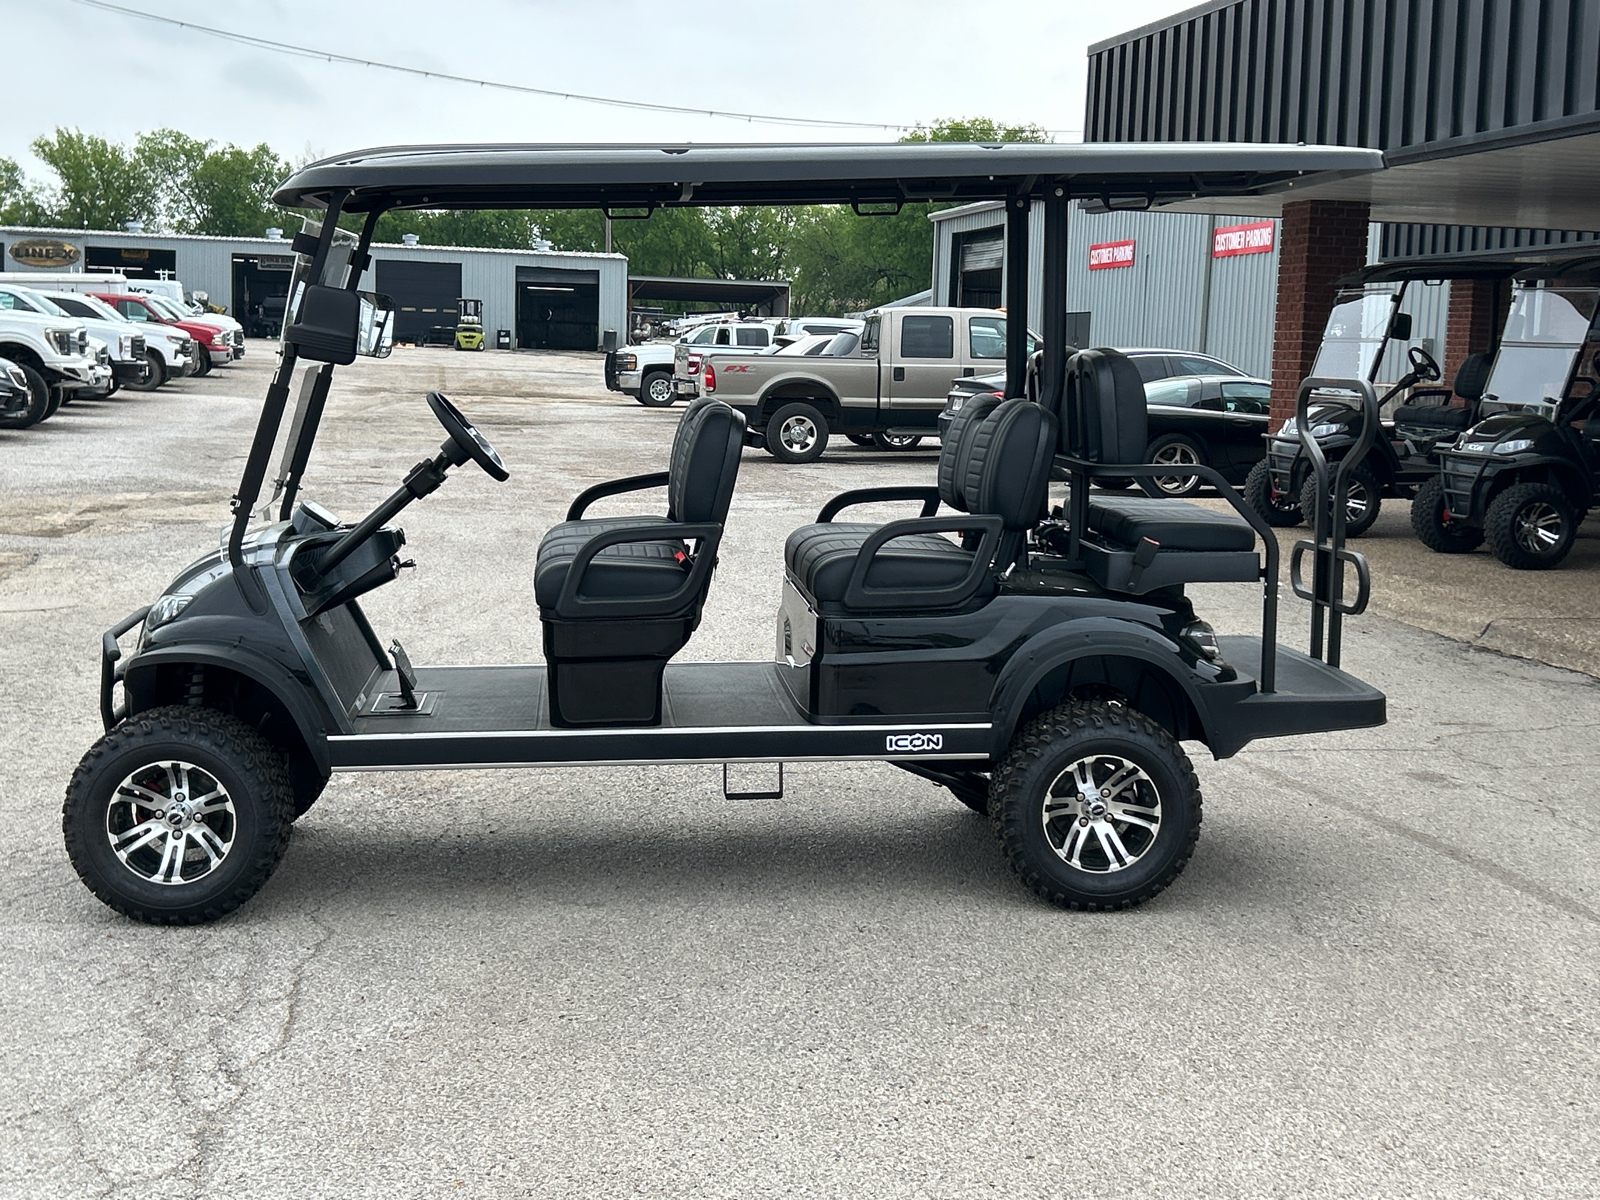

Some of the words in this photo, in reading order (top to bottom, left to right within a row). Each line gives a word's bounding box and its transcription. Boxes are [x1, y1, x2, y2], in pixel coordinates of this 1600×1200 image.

[1215, 231, 1245, 252] CUSTOMER
[1245, 227, 1272, 248] PARKING
[1090, 247, 1113, 265] CUSTOMER
[1113, 244, 1133, 262] PARKING
[886, 732, 943, 751] ICON
